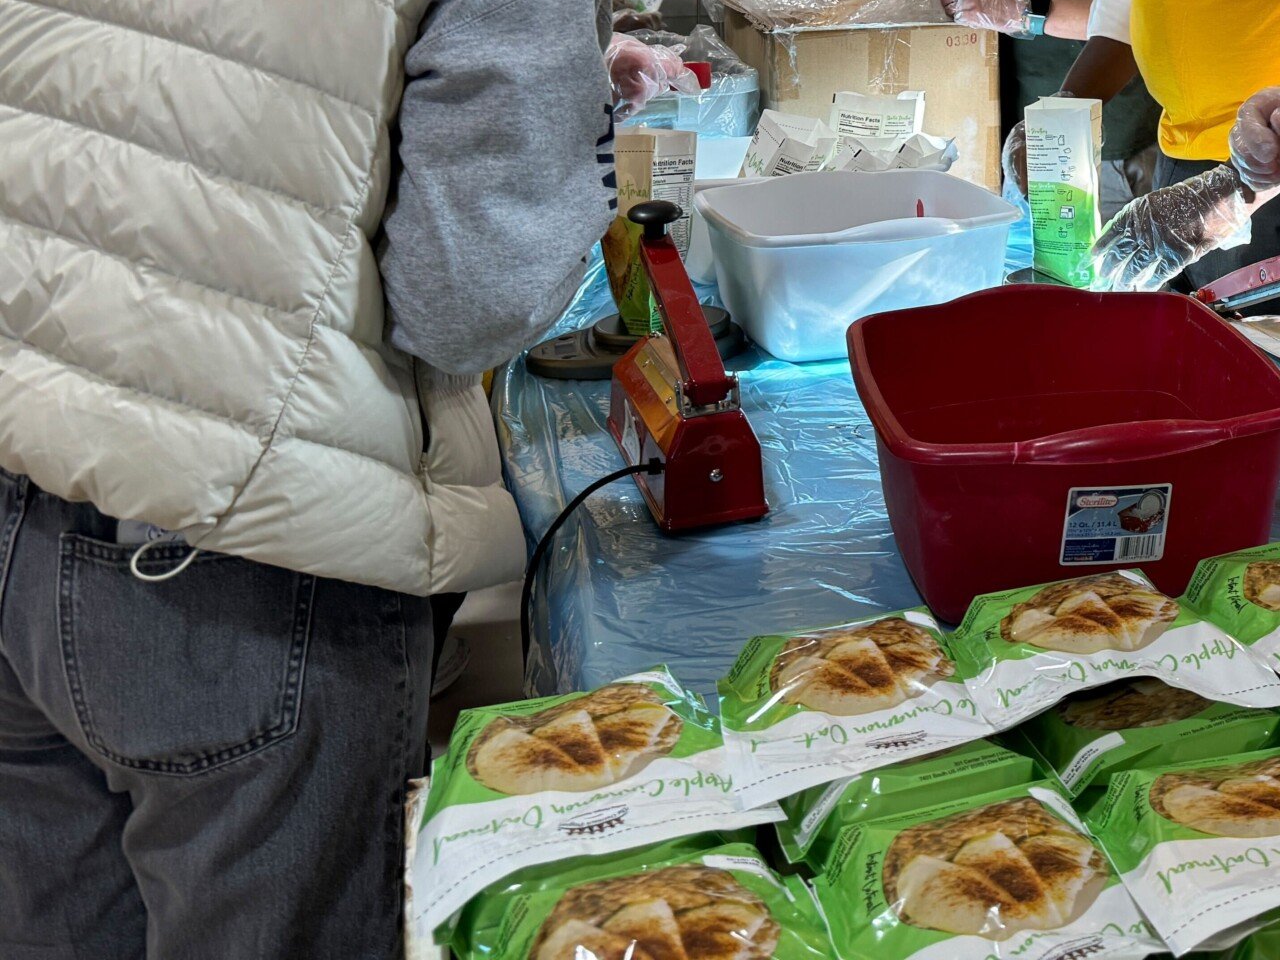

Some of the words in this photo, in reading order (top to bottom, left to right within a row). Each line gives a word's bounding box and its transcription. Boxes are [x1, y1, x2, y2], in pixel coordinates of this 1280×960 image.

[840, 113, 862, 122] Nutrition
[780, 157, 804, 170] Nutrition
[618, 180, 649, 200] atmea
[1080, 496, 1115, 506] Sterilite
[1180, 638, 1240, 670] Apple
[852, 698, 954, 734] Cinnamon
[550, 778, 665, 815] Cinnamon
[670, 770, 733, 797] Apple
[432, 804, 544, 866] Oatmeal
[1156, 847, 1270, 896] Oatmeal
